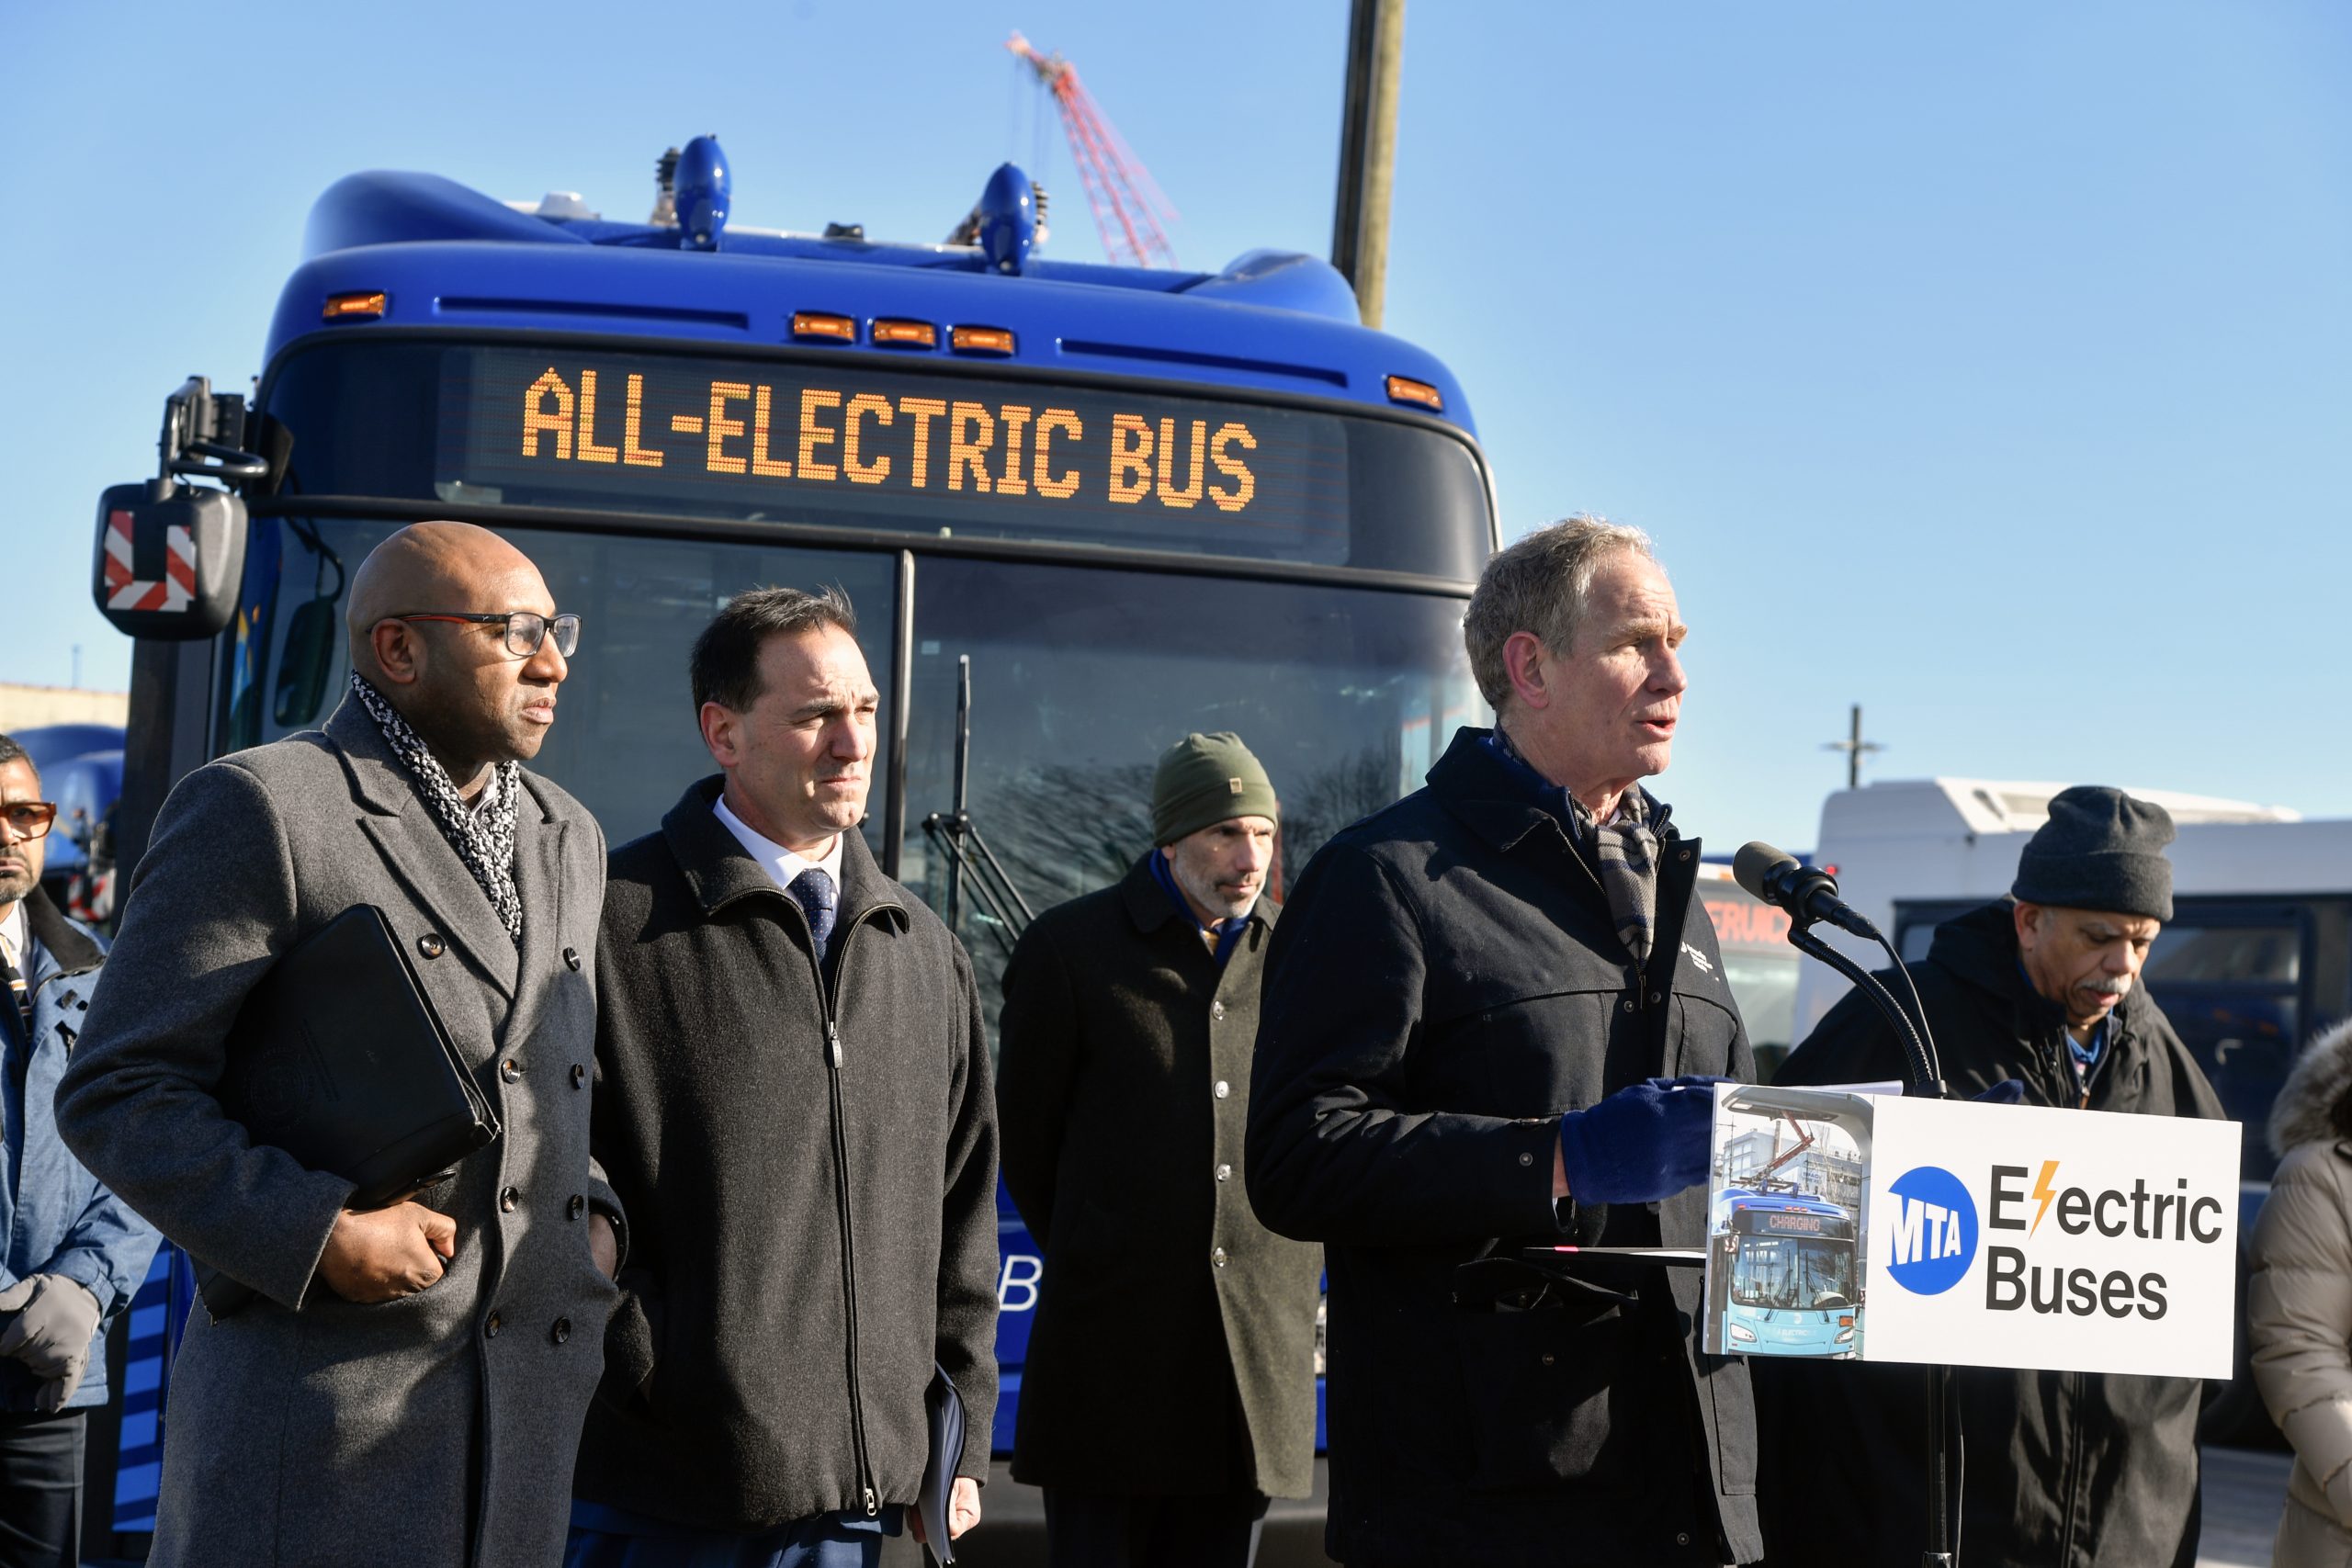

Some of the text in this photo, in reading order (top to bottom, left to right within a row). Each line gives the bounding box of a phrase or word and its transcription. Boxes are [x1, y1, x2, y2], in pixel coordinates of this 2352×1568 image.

[522, 367, 1257, 512] ALL-ELECTRIC BUS
[1889, 1193, 1962, 1267] MTA
[1985, 1246, 2168, 1321] Buses
